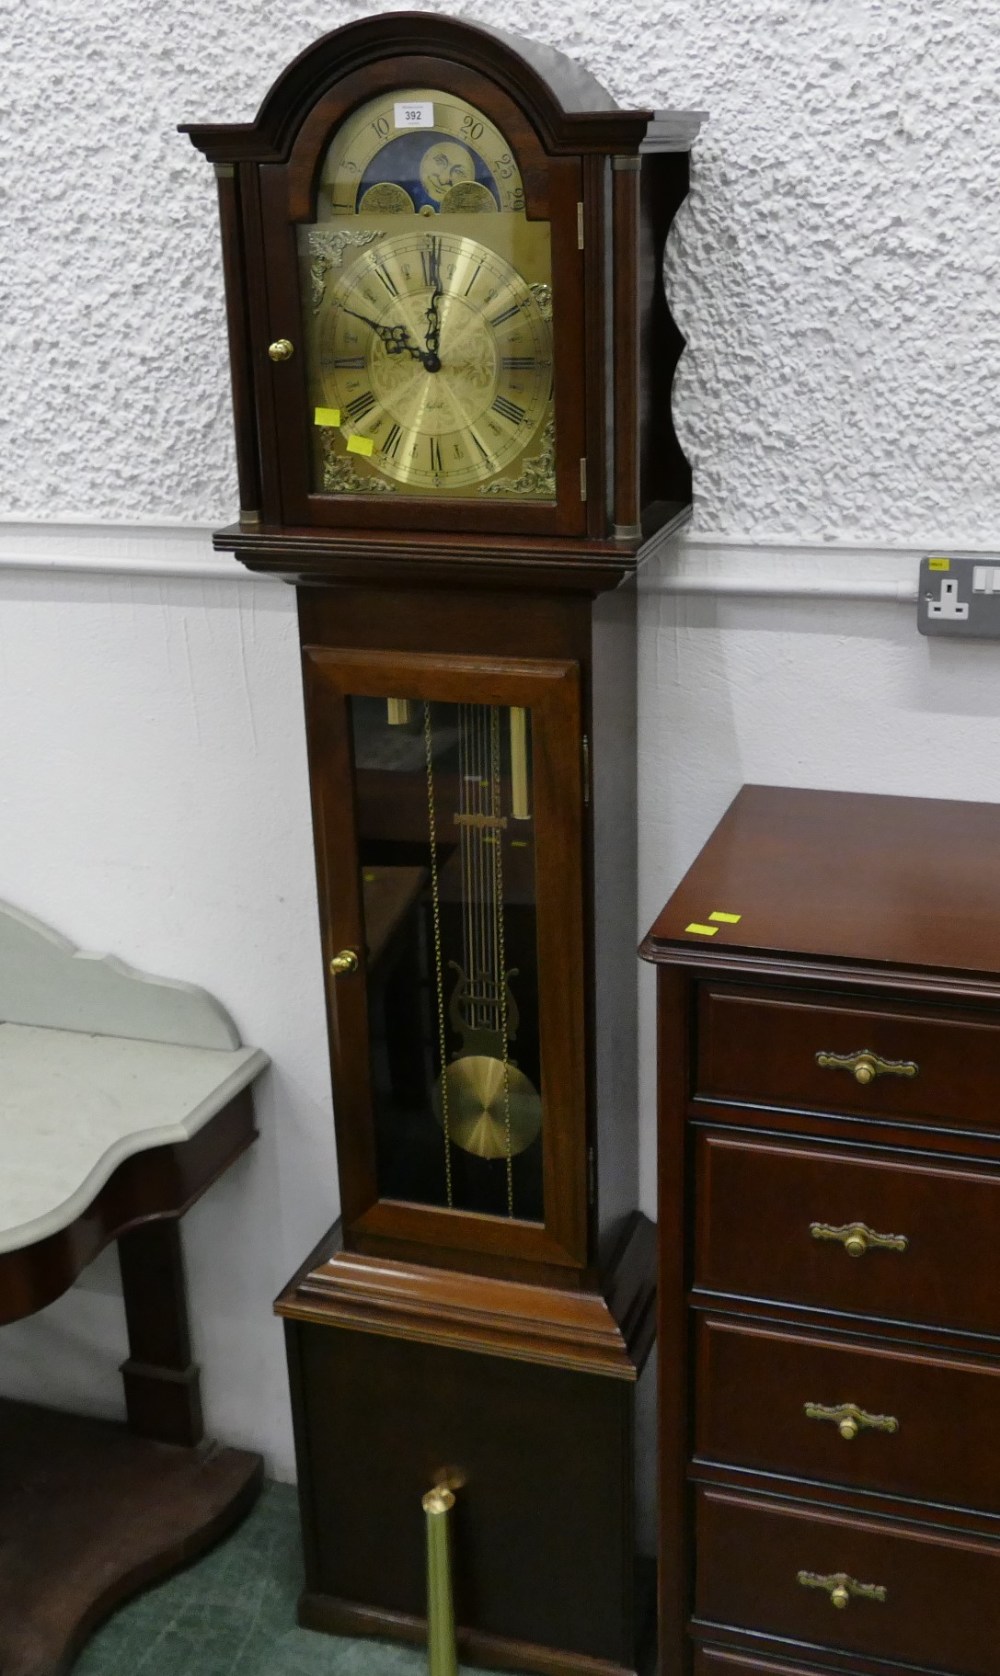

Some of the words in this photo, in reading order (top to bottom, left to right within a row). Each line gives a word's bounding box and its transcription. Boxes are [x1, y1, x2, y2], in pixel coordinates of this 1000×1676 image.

[405, 110, 422, 120] 392
[371, 117, 390, 139] 10
[460, 115, 484, 140] 20
[494, 153, 517, 179] 25
